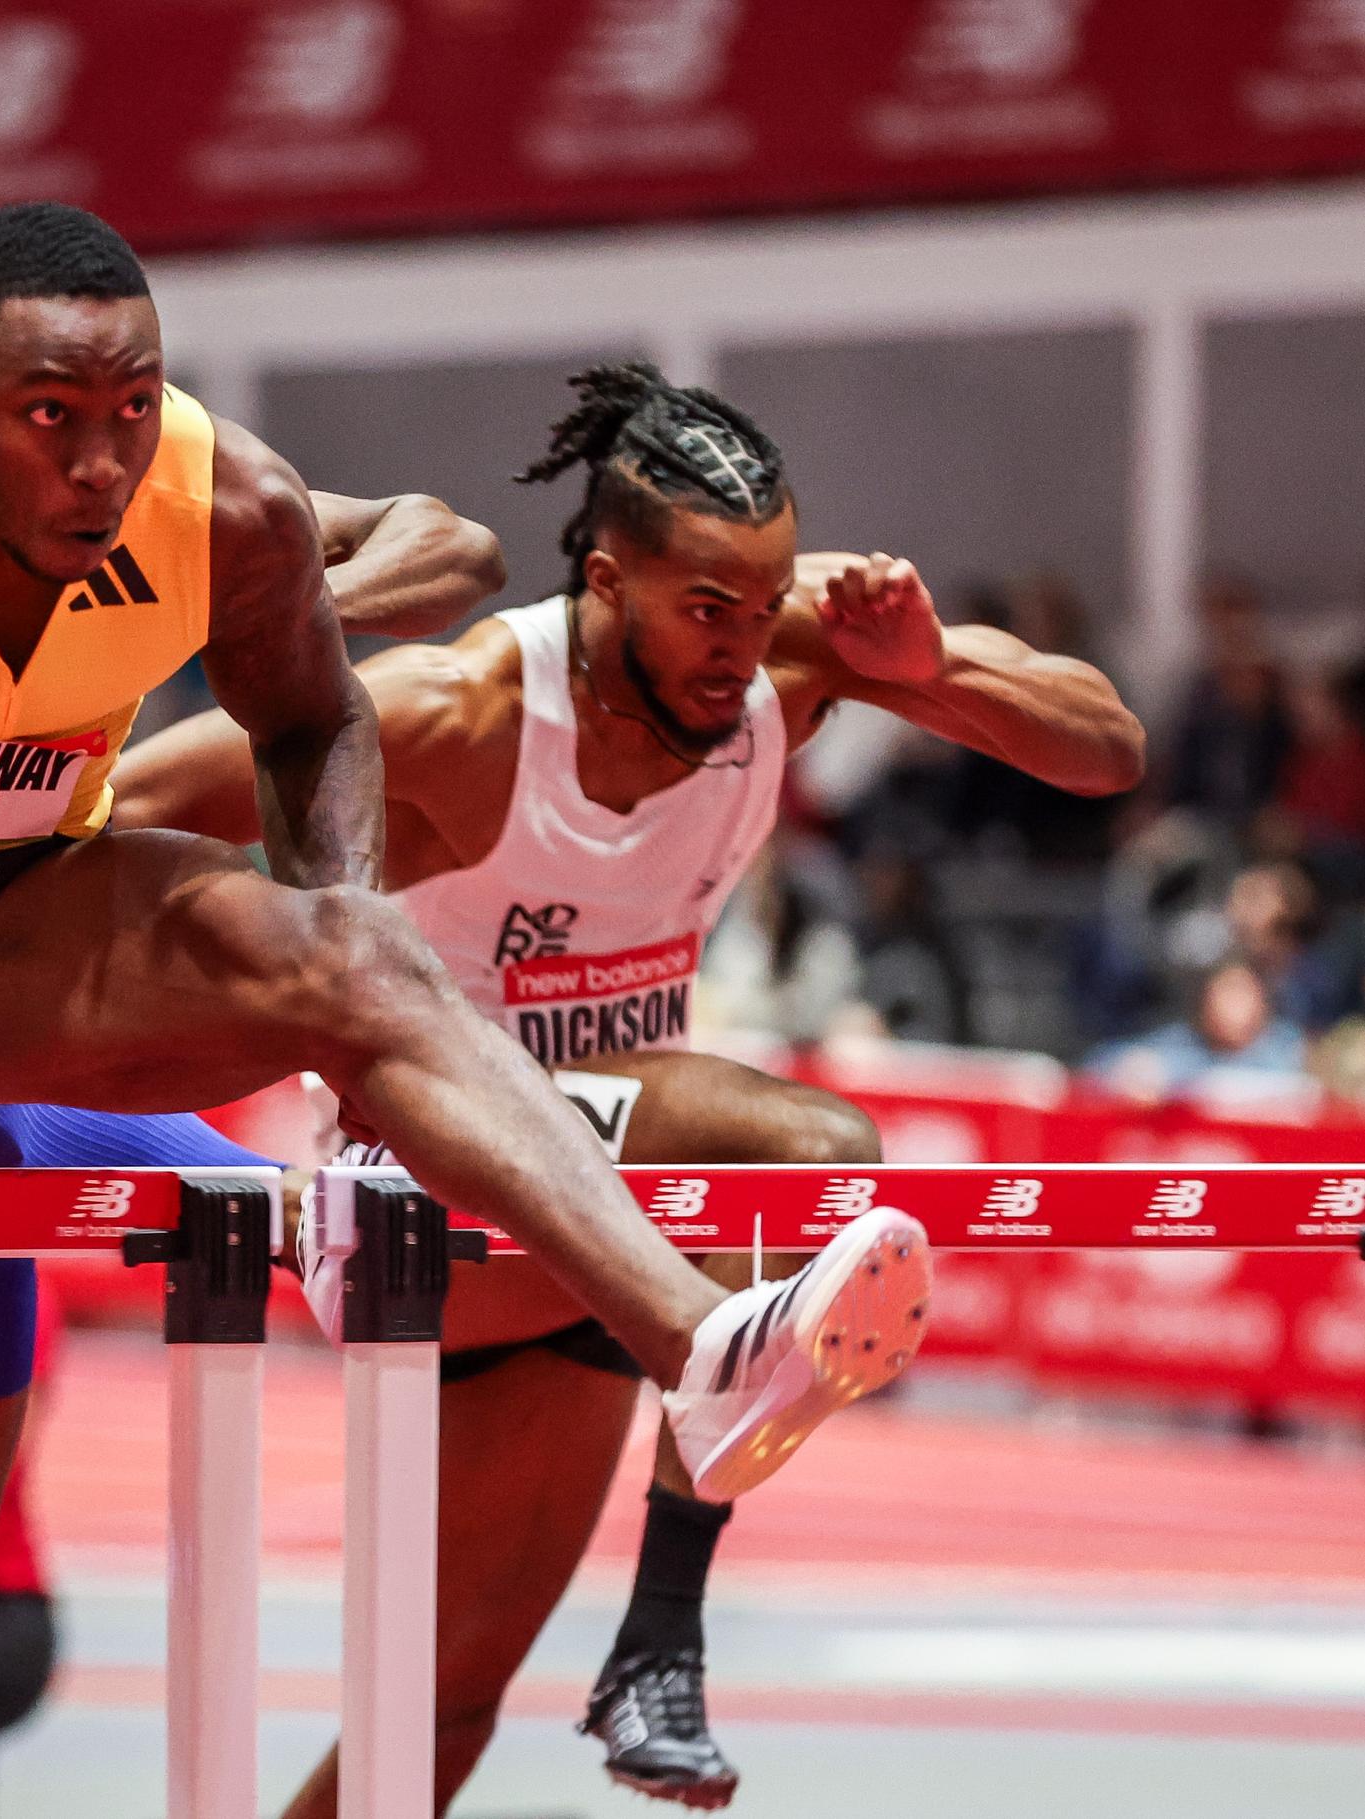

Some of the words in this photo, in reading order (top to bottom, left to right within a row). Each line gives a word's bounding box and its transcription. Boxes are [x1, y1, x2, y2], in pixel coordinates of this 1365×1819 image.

[516, 969, 581, 997] new
[587, 950, 690, 992] balance
[519, 983, 688, 1067] DICKSON
[55, 1226, 85, 1237] new
[800, 1223, 828, 1235] new
[967, 1224, 994, 1236] new
[996, 1222, 1052, 1236] balance
[1131, 1224, 1158, 1236] new
[1161, 1222, 1217, 1236] balance
[1296, 1223, 1323, 1235] new
